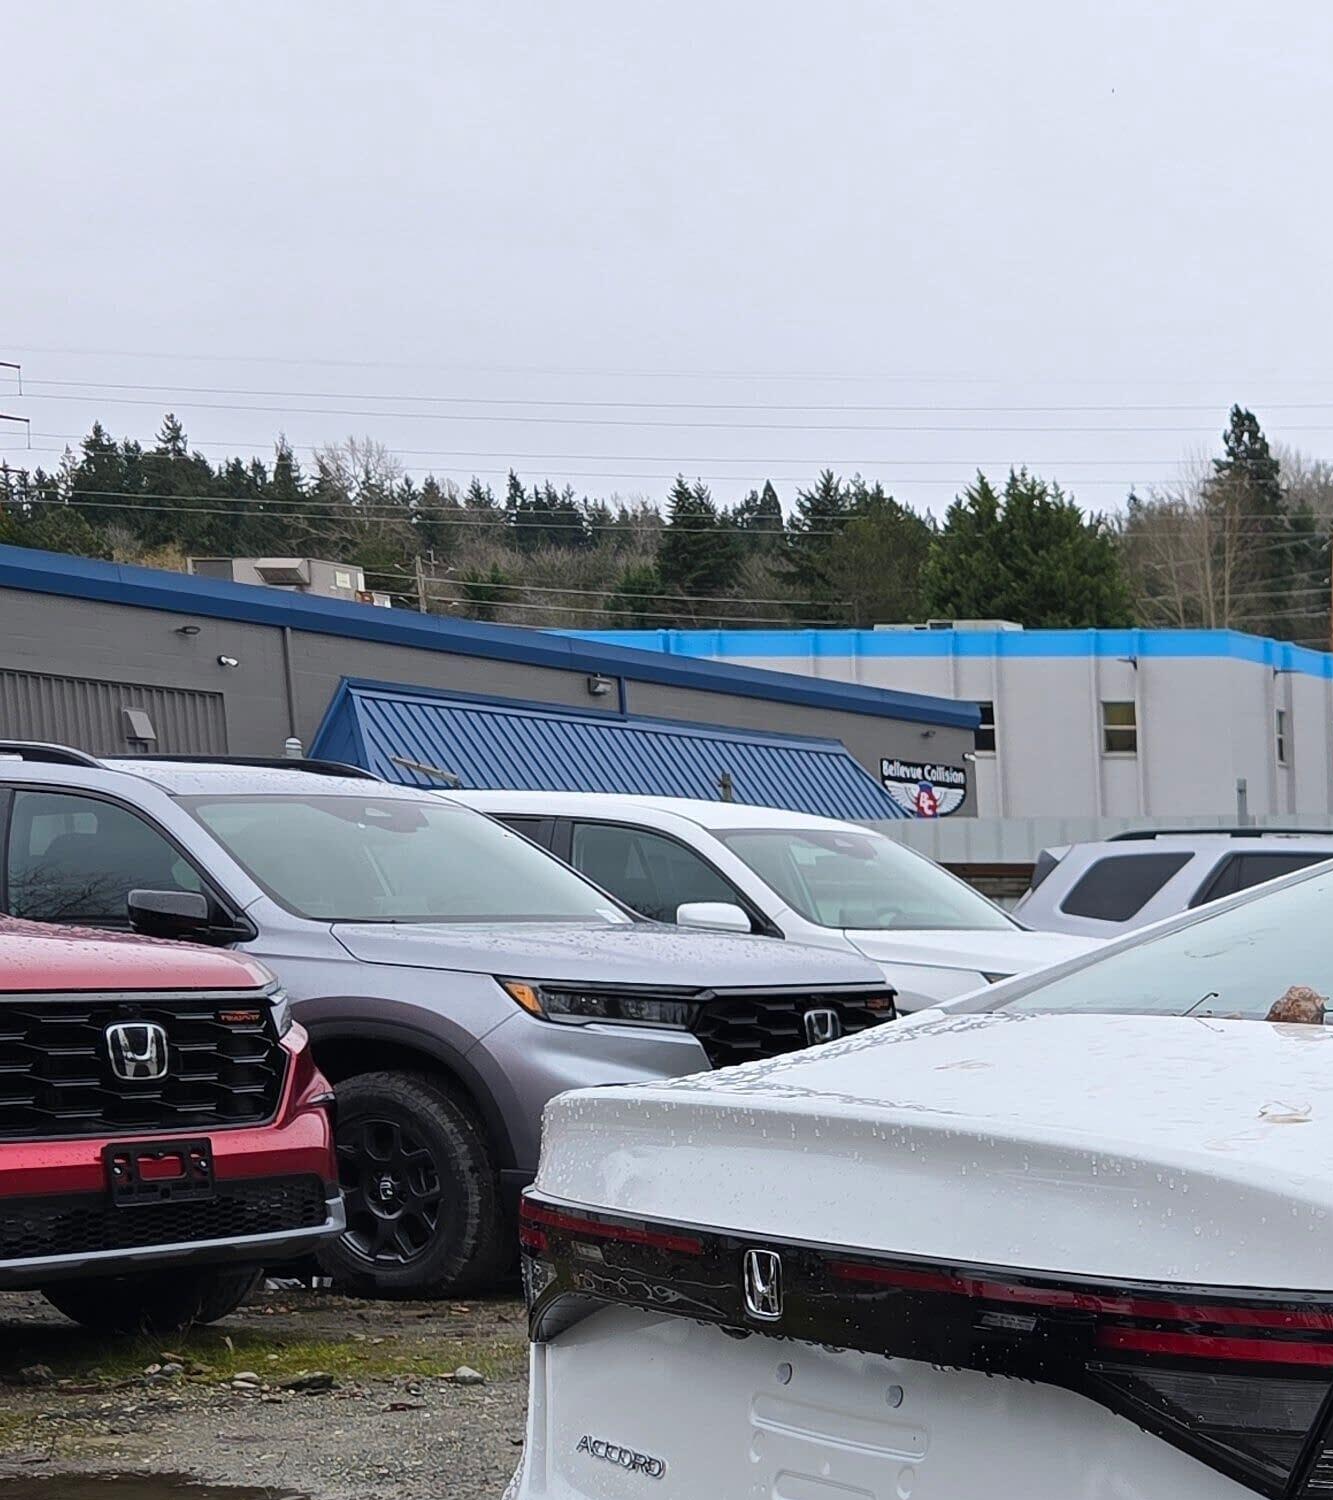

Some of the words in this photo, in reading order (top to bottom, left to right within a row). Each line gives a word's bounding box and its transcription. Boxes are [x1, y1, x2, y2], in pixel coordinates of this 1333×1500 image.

[882, 760, 922, 780] Bellevue
[924, 764, 964, 784] Collision
[576, 1435, 666, 1480] ACCORD
